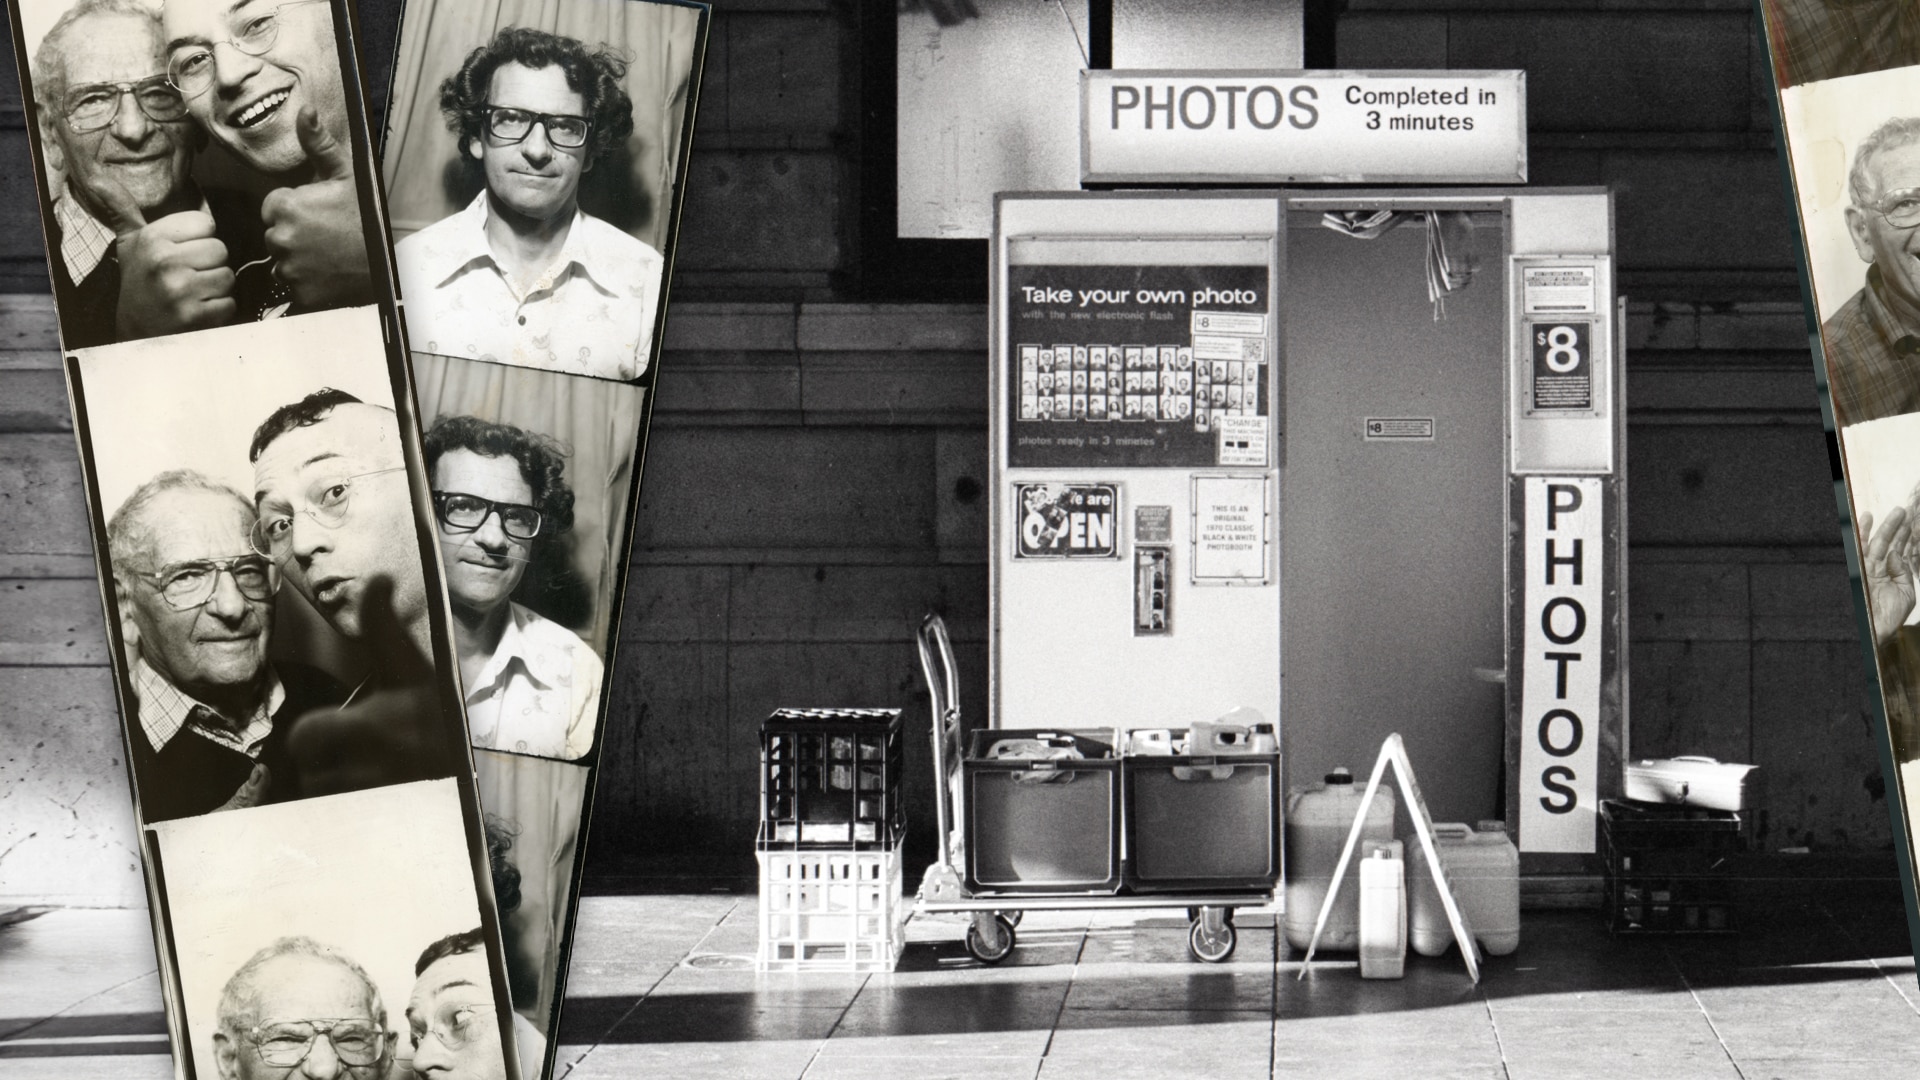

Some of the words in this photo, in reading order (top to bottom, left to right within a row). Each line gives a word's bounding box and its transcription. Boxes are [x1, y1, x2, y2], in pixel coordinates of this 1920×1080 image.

[1111, 85, 1319, 130] PHOTOS
[1345, 85, 1468, 109] Completed
[1478, 88, 1496, 105] in
[1366, 110, 1381, 130] 3
[1389, 114, 1474, 130] minutes
[1021, 286, 1074, 303] Take
[1079, 289, 1131, 307] your
[1136, 289, 1186, 304] own
[1192, 287, 1257, 308] photo
[1022, 310, 1044, 320] with
[1049, 310, 1067, 320] the
[1071, 312, 1092, 320] new
[1096, 310, 1146, 320] electronic
[1150, 311, 1174, 320] flash
[1536, 325, 1580, 373] $8
[1018, 436, 1052, 447] photos
[1057, 436, 1085, 447] ready
[1089, 436, 1099, 445] in
[1102, 435, 1111, 446] 3
[1115, 437, 1156, 446] minutes
[1086, 494, 1111, 506] are
[1023, 511, 1111, 549] OPEN
[1538, 483, 1587, 815] PHOTOS
